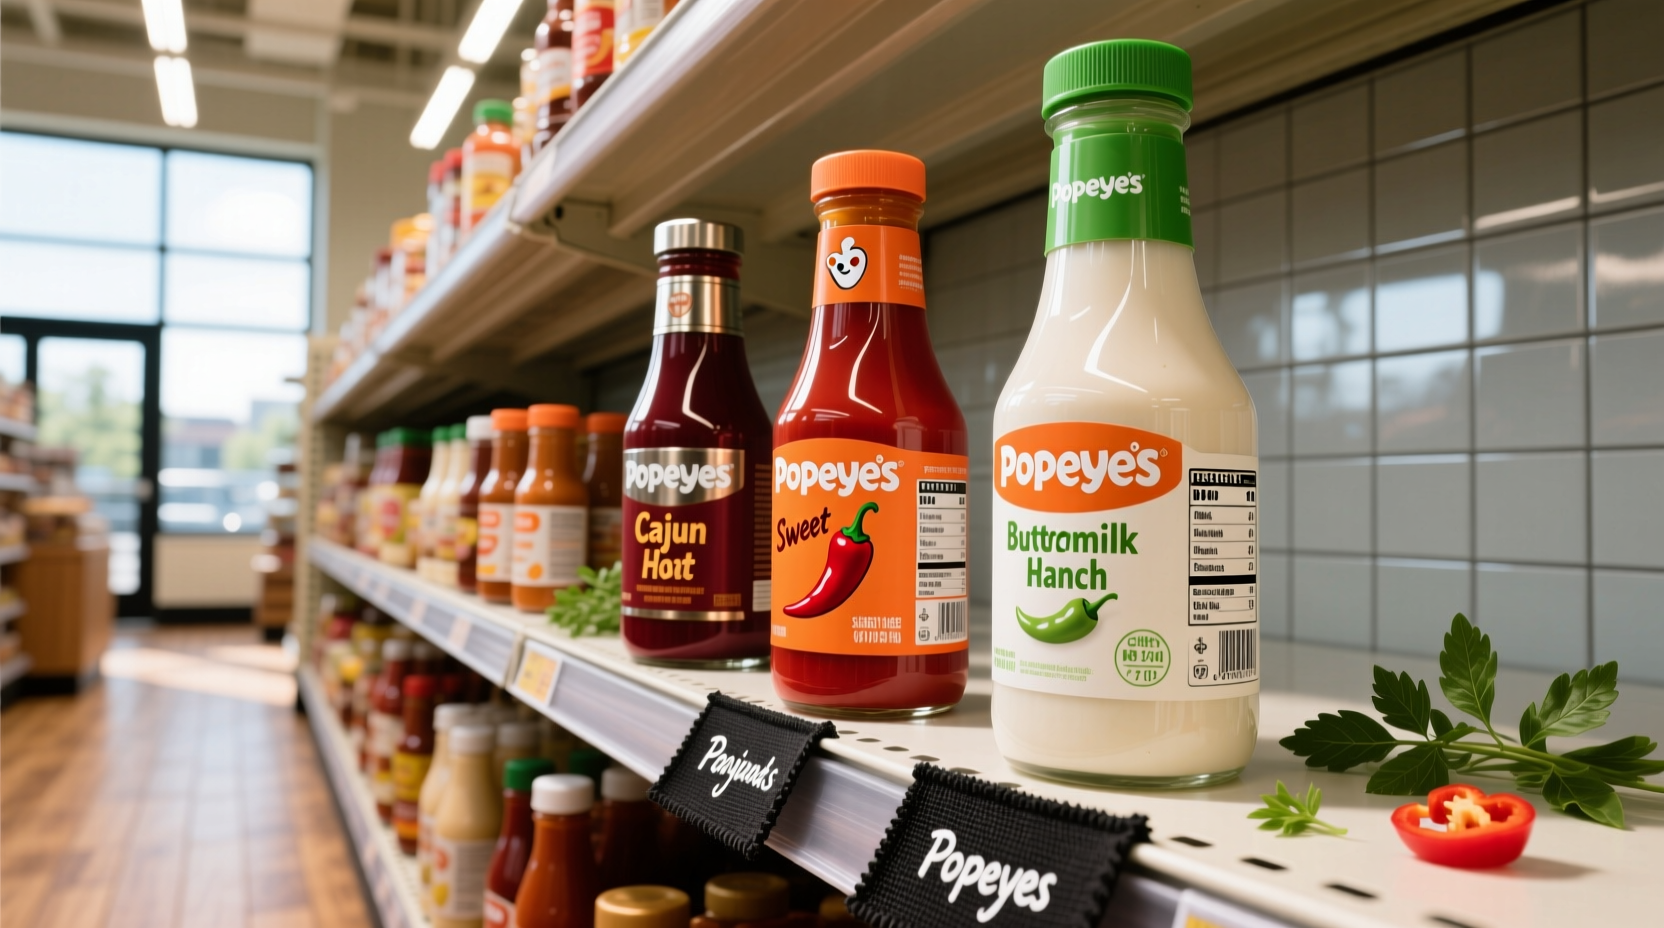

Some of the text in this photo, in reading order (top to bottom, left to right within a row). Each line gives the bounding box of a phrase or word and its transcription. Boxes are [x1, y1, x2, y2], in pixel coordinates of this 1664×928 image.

[625, 460, 728, 494] Popeyes
[634, 510, 707, 554] Cajun
[777, 506, 832, 553] Sweet
[1026, 556, 1107, 591] Hanch
[917, 828, 1058, 924] Popeyes
